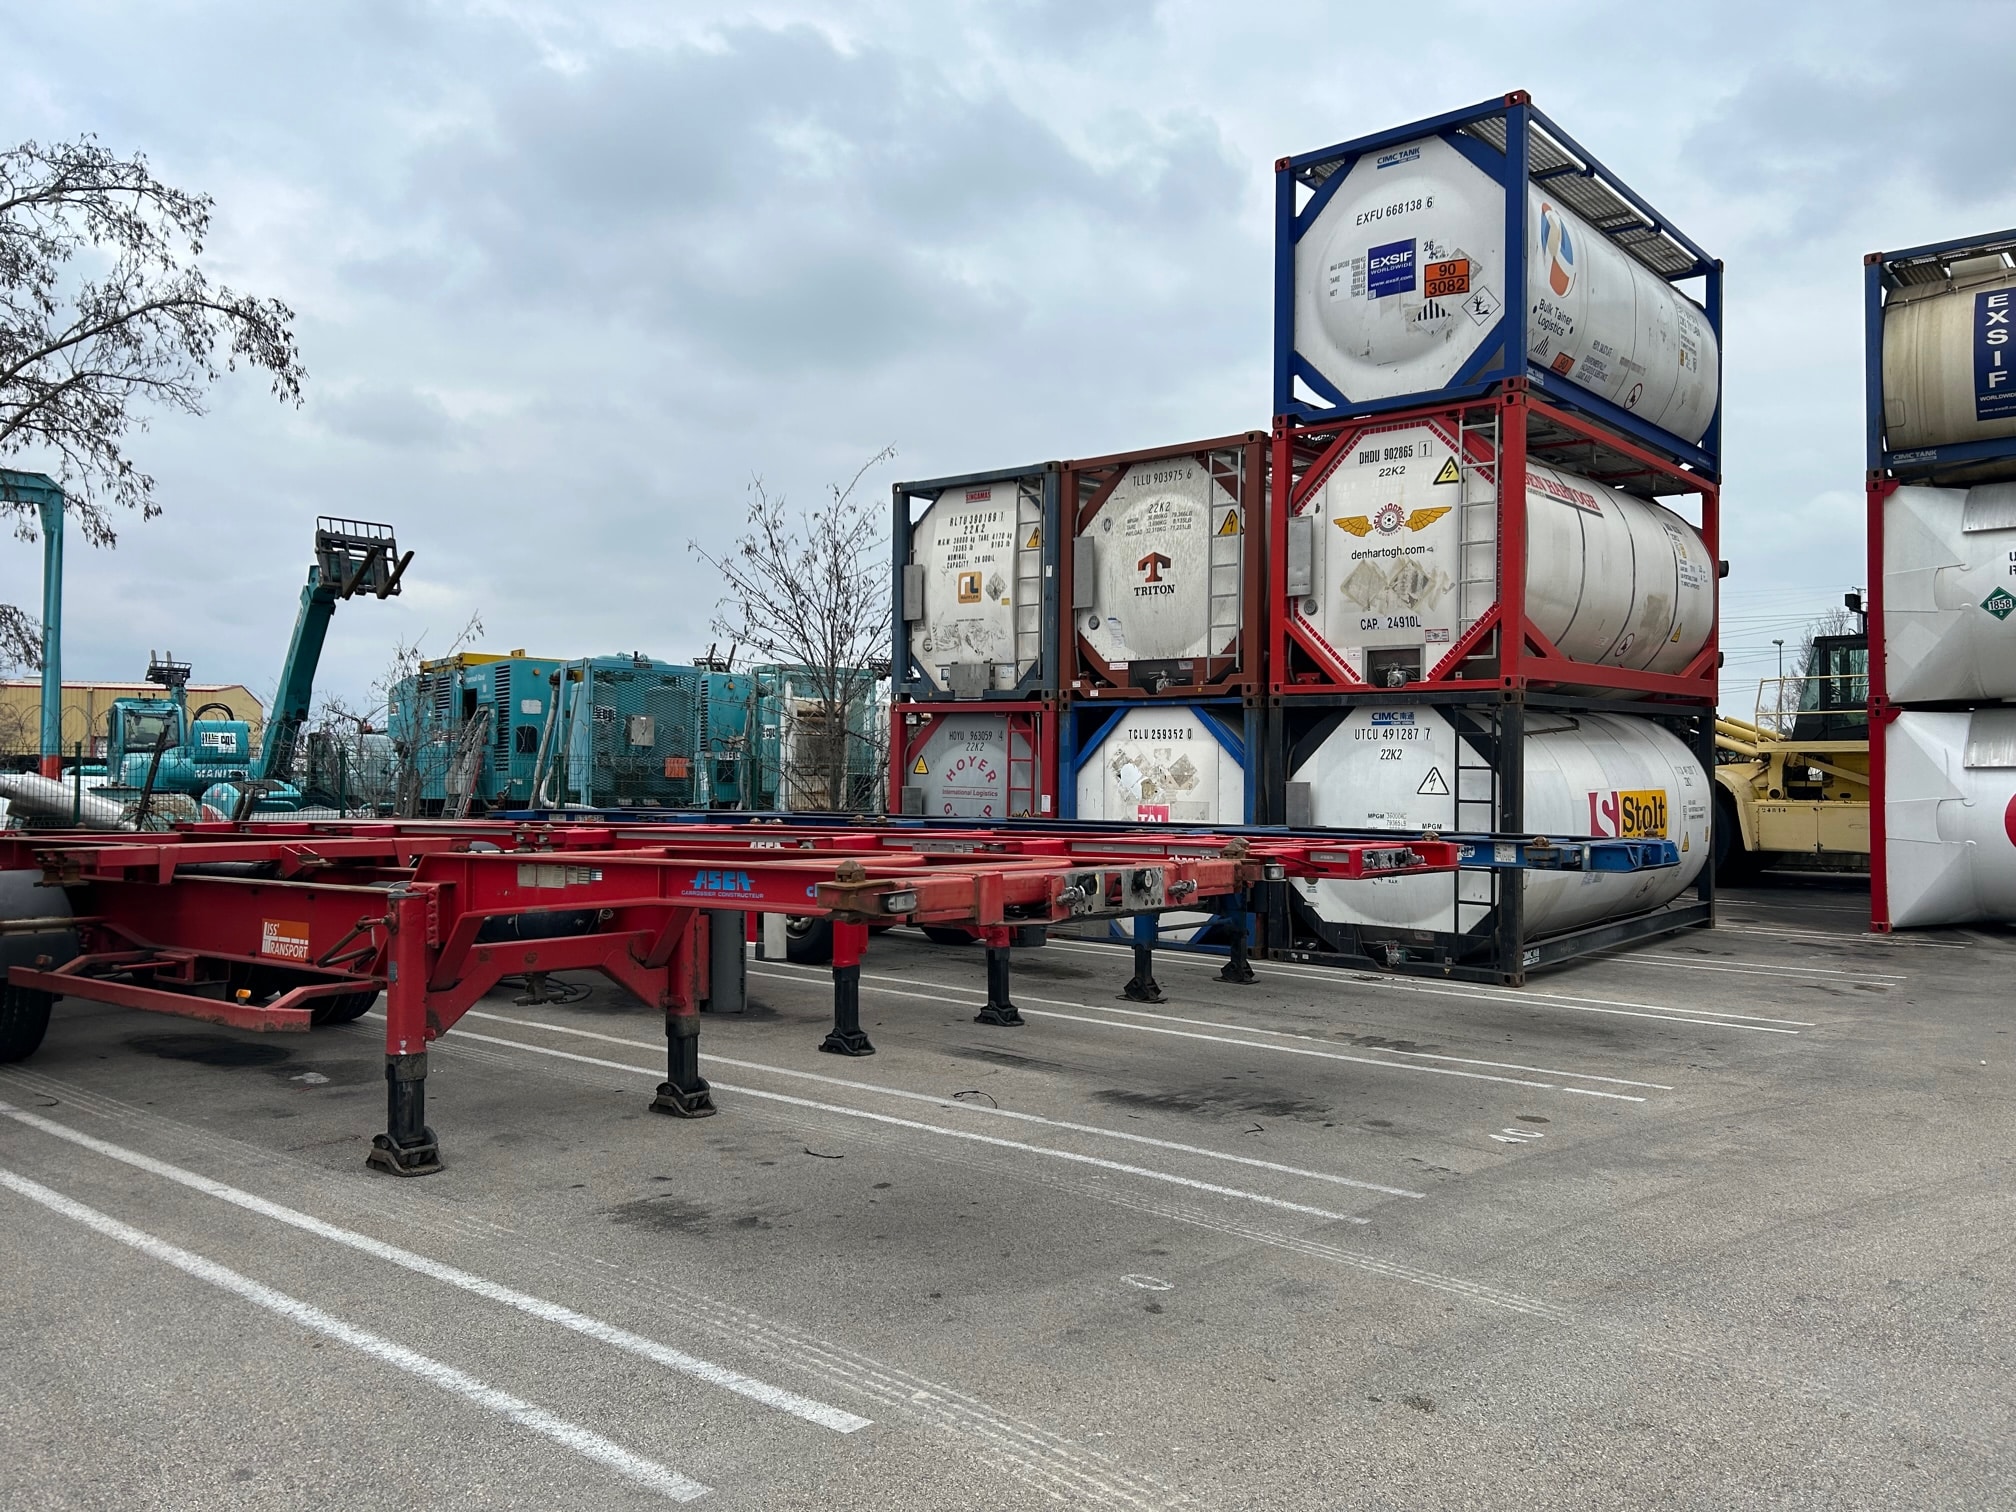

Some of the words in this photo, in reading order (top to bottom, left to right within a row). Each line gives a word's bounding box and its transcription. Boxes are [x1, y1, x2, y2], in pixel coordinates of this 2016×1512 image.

[1377, 152, 1398, 165] CIMC
[1399, 146, 1420, 159] TANK
[1356, 208, 1384, 226] EXFU
[1386, 198, 1422, 217] 668138
[1426, 196, 1433, 208] 6
[1370, 251, 1413, 270] EXSIF
[1370, 261, 1413, 275] WORLDWIDE
[1438, 263, 1456, 277] 90
[1428, 278, 1465, 295] 3082
[1986, 294, 2009, 388] EXSIF
[1980, 392, 2016, 402] WORLDWID
[1359, 450, 1380, 465] DHDU
[1384, 445, 1413, 461] 902865
[1133, 473, 1151, 487] TLLU
[1153, 469, 1183, 484] 903975
[1187, 468, 1192, 479] 6
[1379, 465, 1406, 477] 22K2
[1148, 501, 1171, 514] 22K2
[950, 515, 968, 527] RLTU
[963, 523, 986, 535] 22K2
[1351, 545, 1425, 560] denhartogh.com
[1134, 584, 1175, 597] TRITON
[1989, 600, 2011, 611] 1858
[1360, 618, 1380, 631] CAP.
[1387, 615, 1422, 629] 24910L
[1371, 711, 1399, 721] CIMC
[949, 730, 965, 741] HOYU
[969, 730, 993, 741] 963059
[1128, 728, 1149, 740] TCLU
[1151, 728, 1184, 740] 259352
[1354, 728, 1379, 741] UTCU
[1382, 728, 1419, 741] 491287
[1425, 728, 1431, 741] 7
[965, 742, 985, 752] 22K2
[1380, 748, 1403, 761] 22K2
[194, 769, 249, 779] MANIT
[945, 755, 997, 783] HOYER
[942, 788, 973, 796] International
[972, 789, 998, 798] Logistics
[1622, 795, 1666, 833] Stolt
[1421, 822, 1442, 830] MPGM
[717, 891, 764, 899] CONSTRUCTEUR
